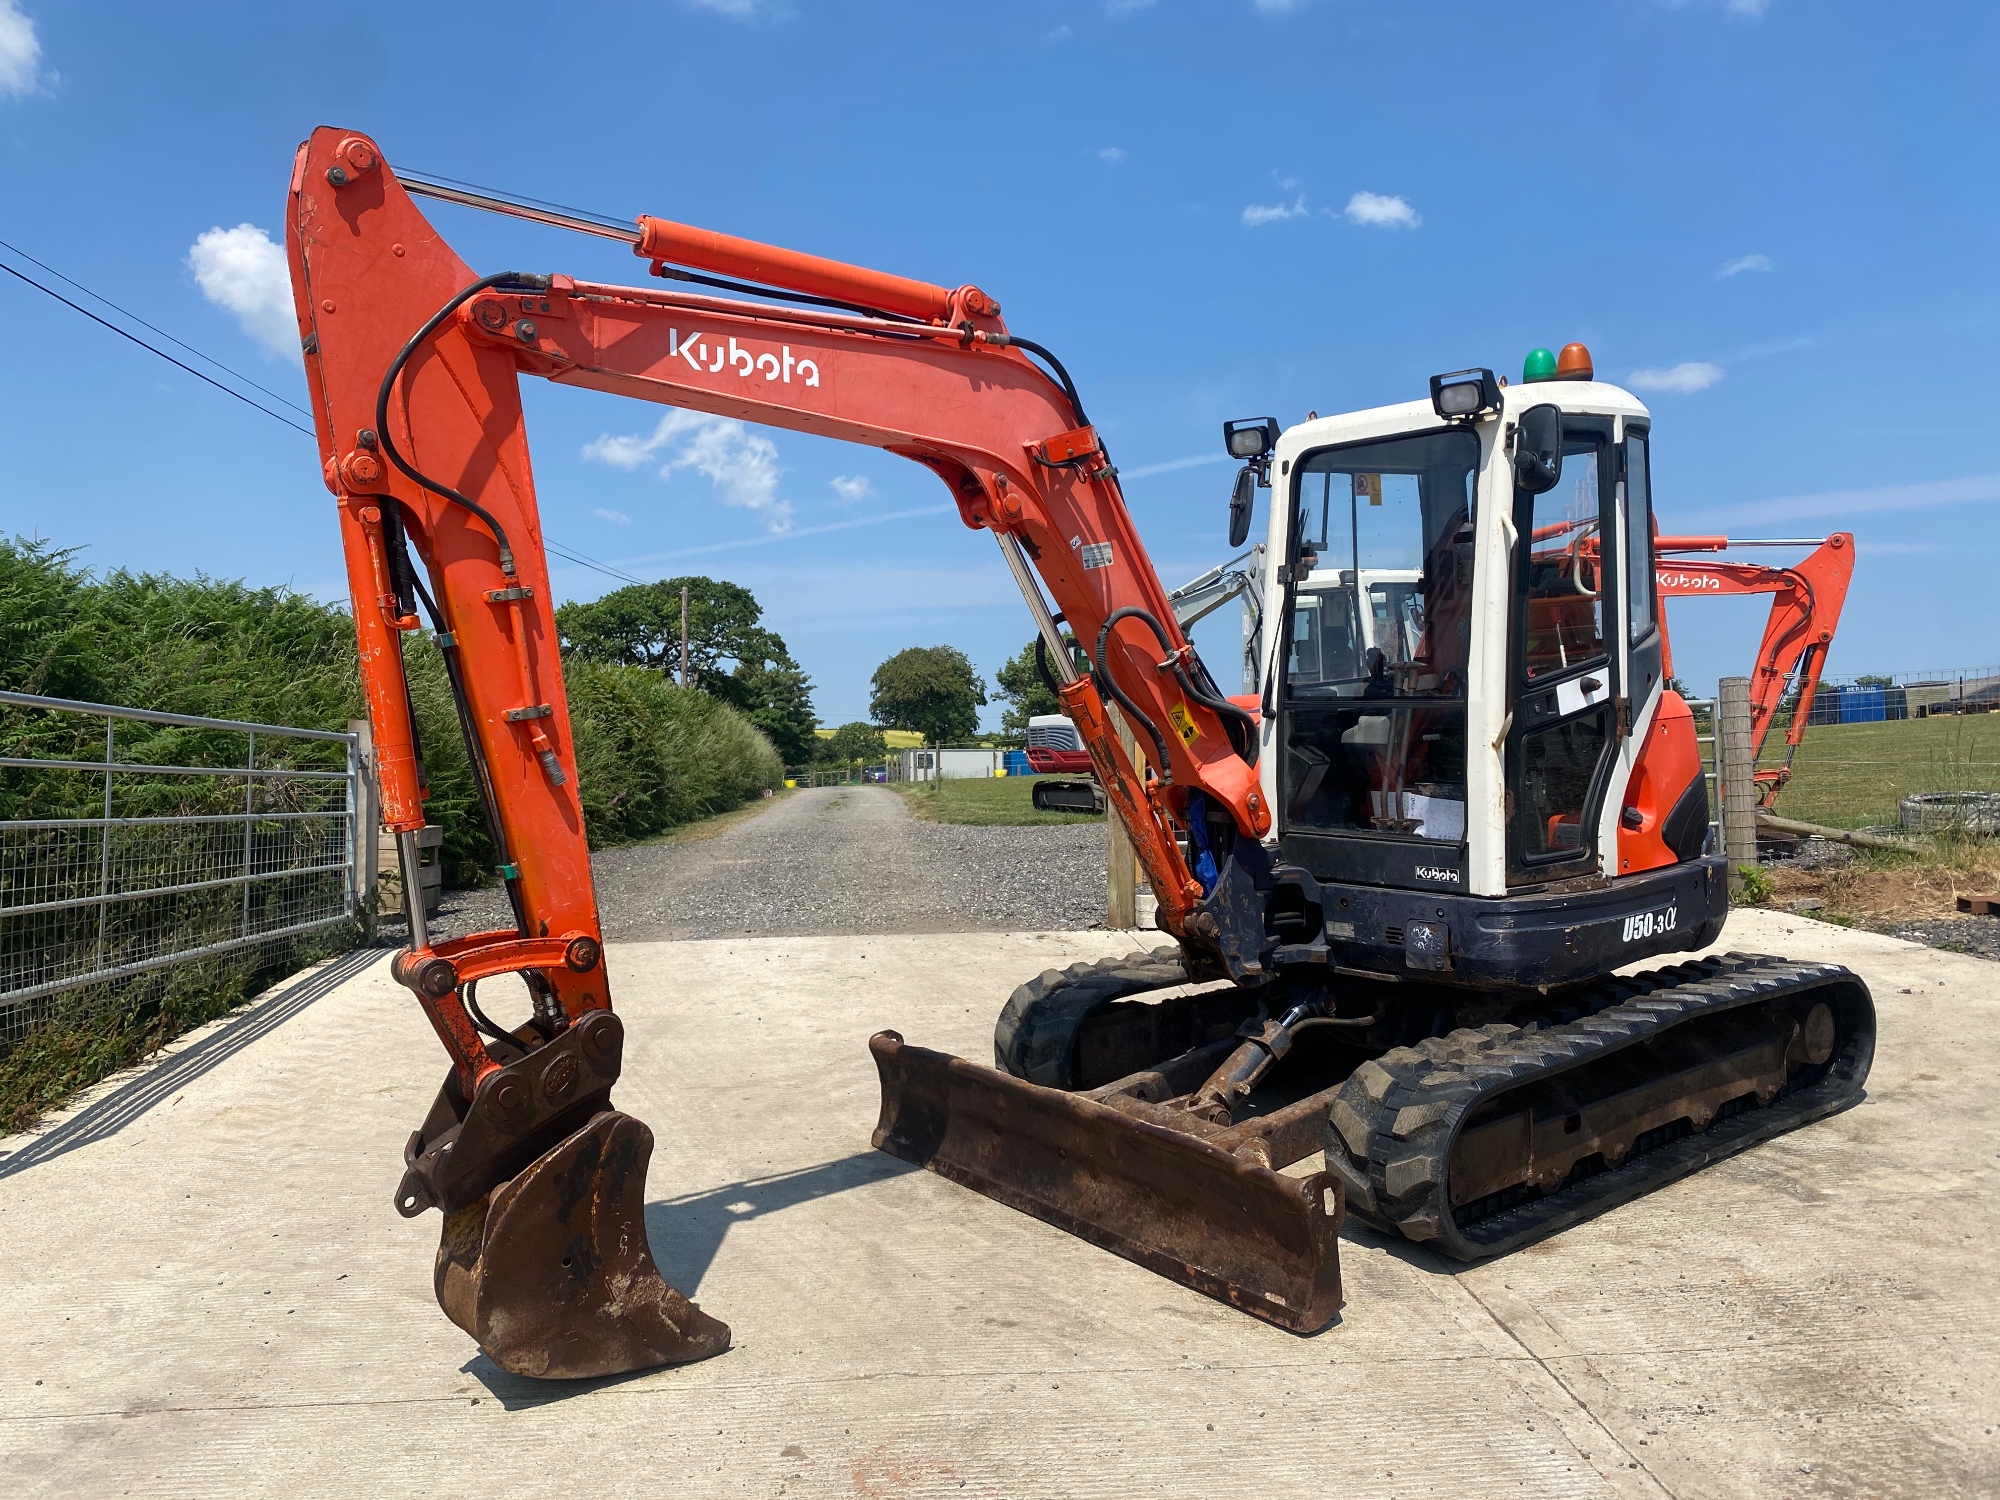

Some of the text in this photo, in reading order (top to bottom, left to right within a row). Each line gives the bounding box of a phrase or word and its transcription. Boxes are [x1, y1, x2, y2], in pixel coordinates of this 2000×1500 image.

[669, 327, 820, 388] Kubota
[1655, 572, 1720, 589] Kubota
[1416, 867, 1458, 882] Kubota
